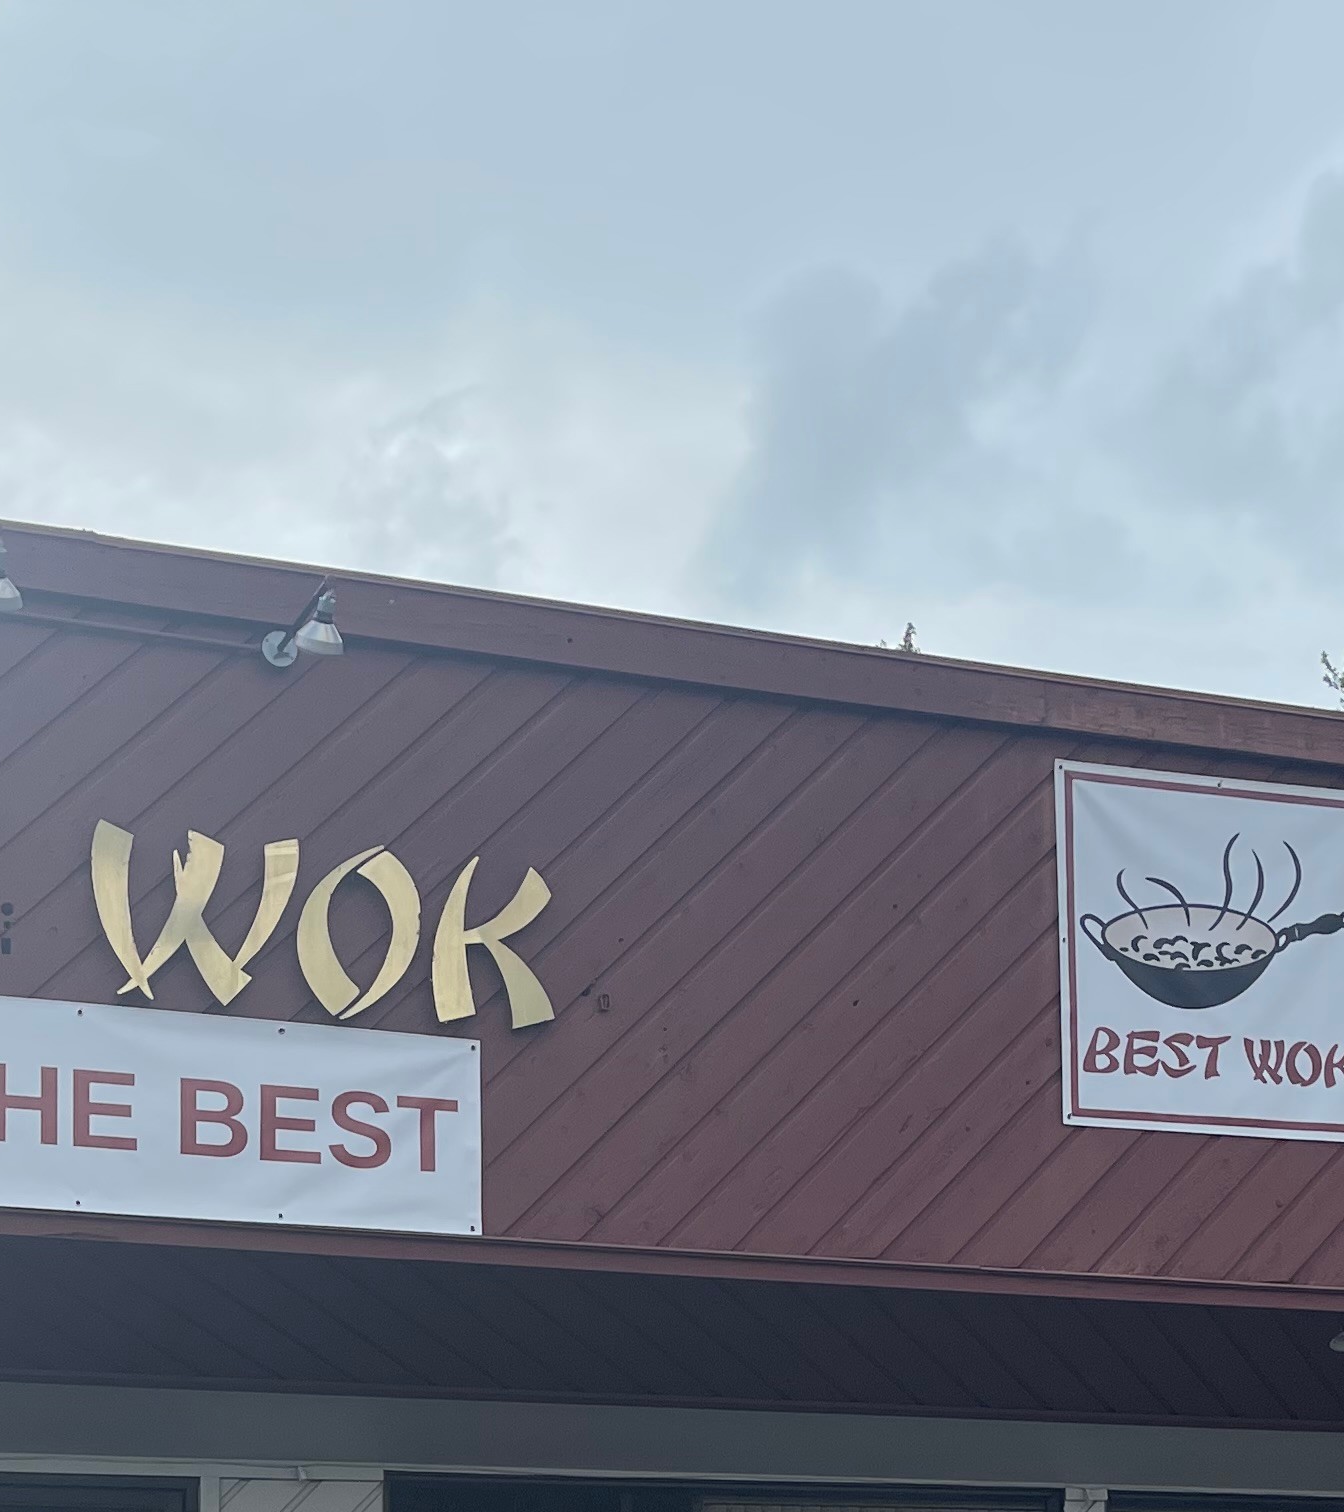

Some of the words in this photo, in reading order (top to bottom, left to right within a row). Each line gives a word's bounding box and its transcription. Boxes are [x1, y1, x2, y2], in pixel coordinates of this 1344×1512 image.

[90, 818, 556, 1030] WOK
[1081, 1026, 1231, 1081] BEST
[178, 1076, 460, 1174] BEST
